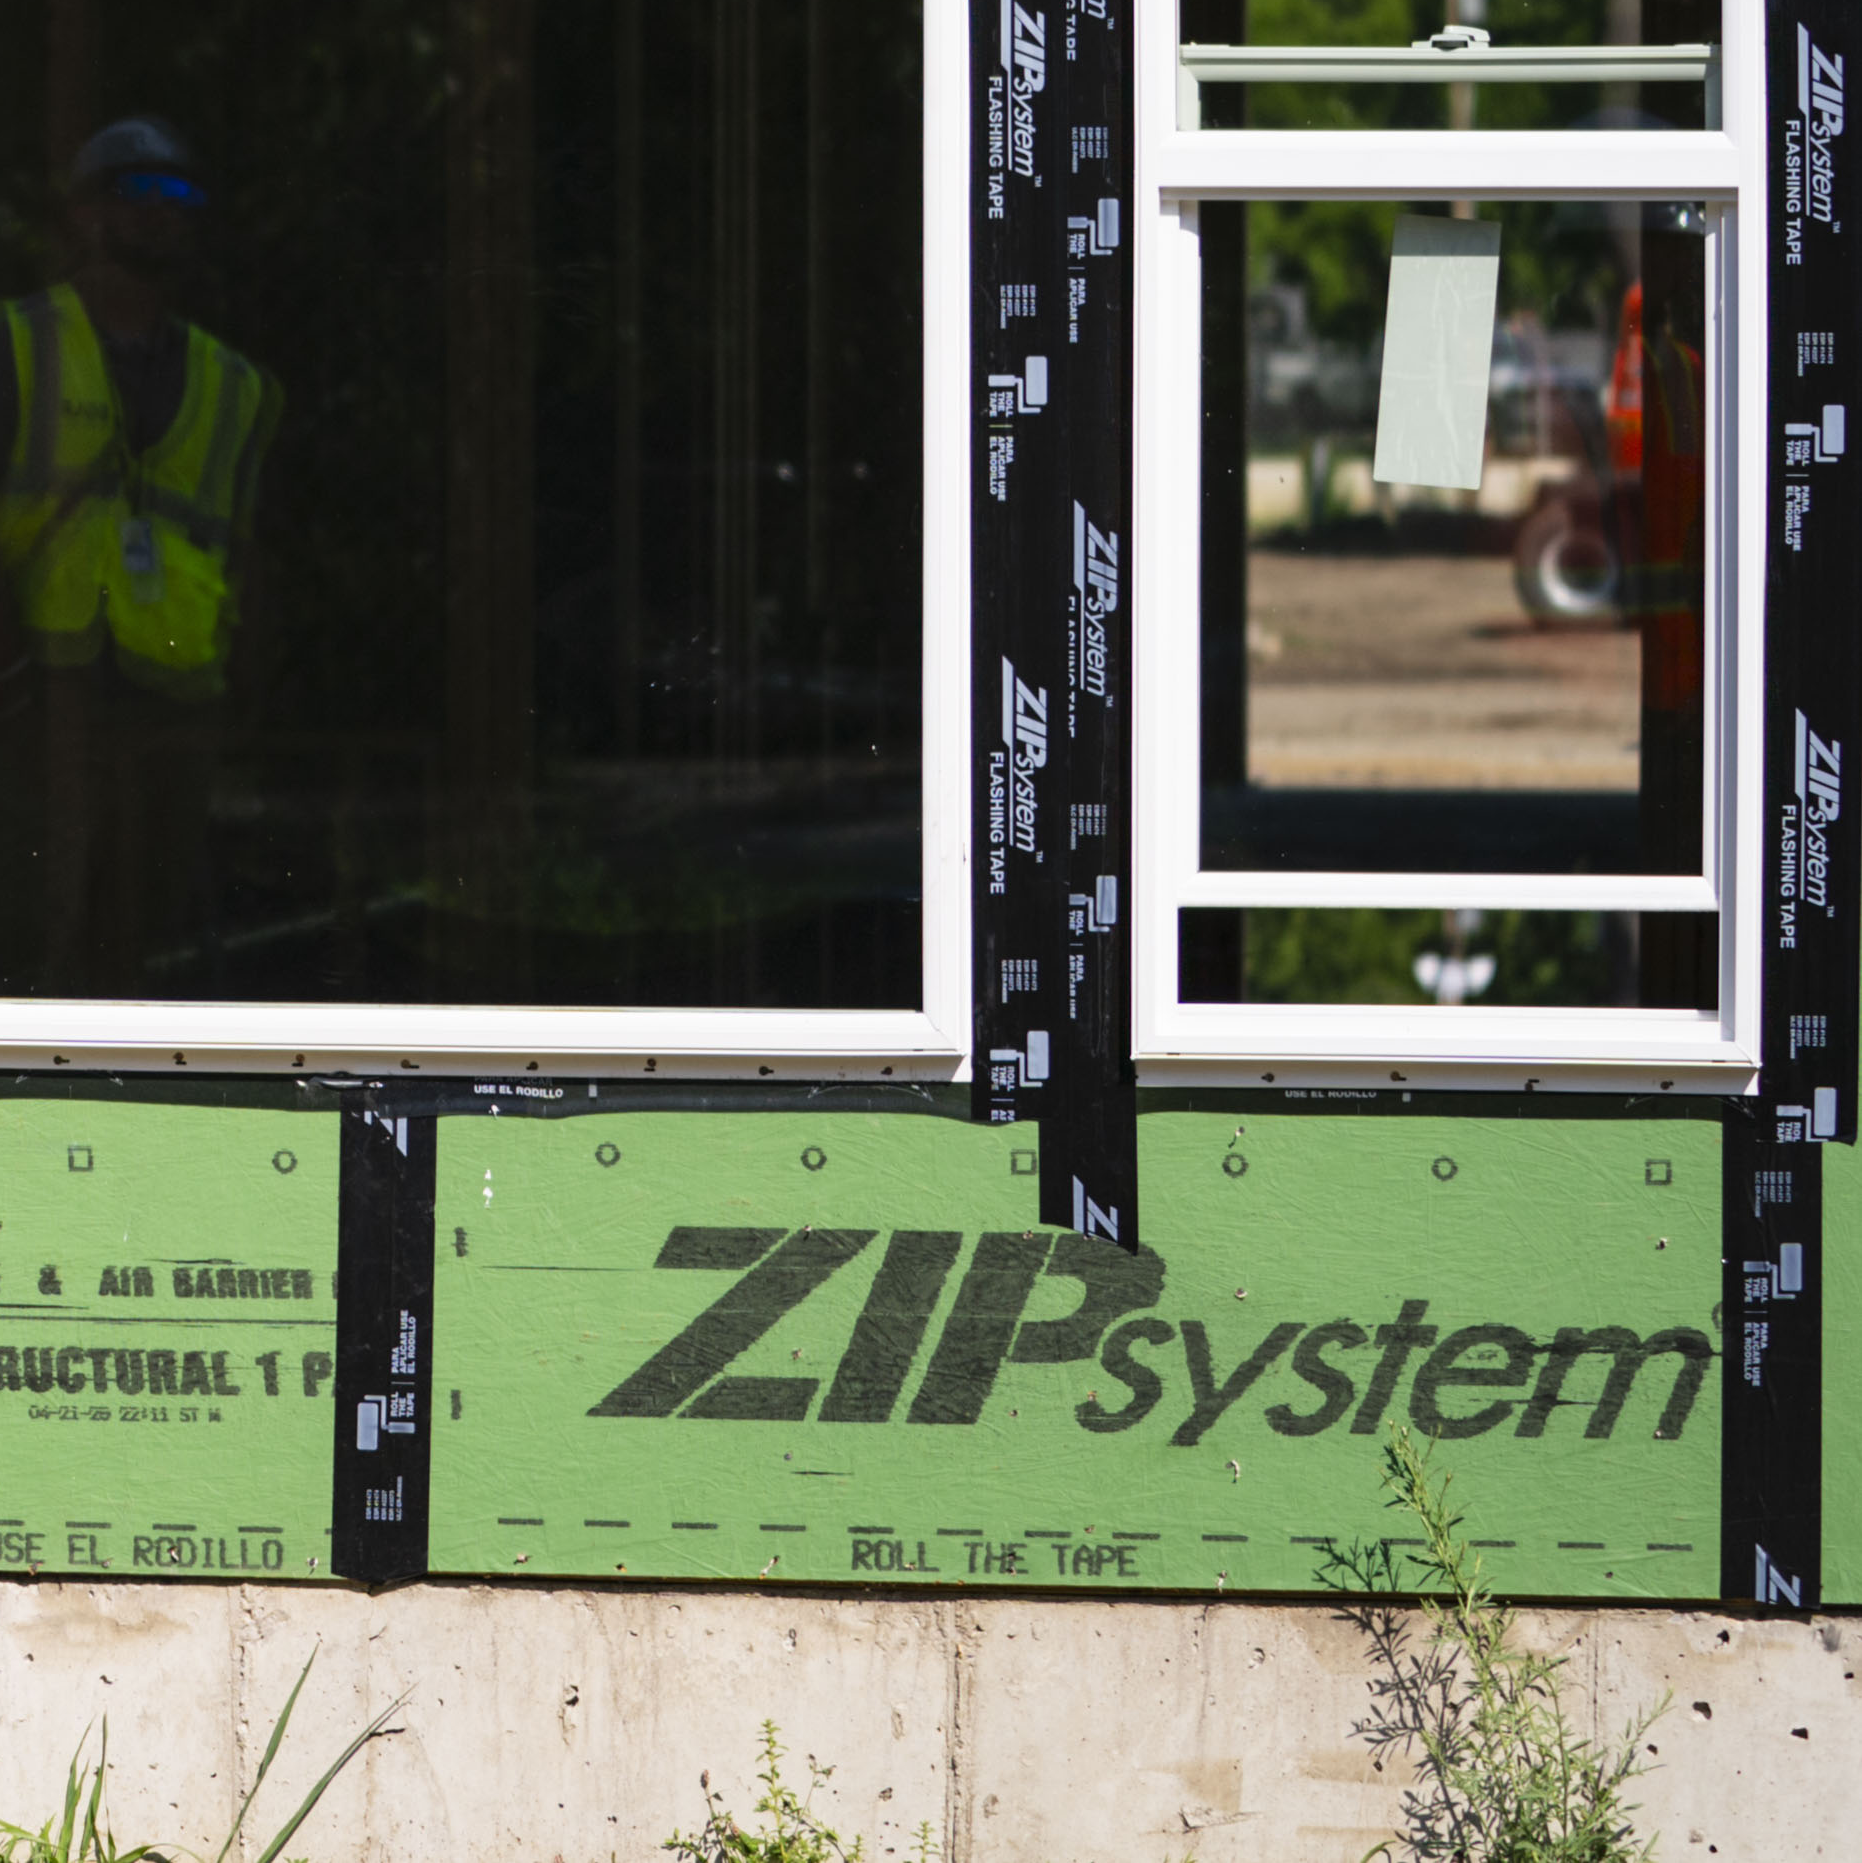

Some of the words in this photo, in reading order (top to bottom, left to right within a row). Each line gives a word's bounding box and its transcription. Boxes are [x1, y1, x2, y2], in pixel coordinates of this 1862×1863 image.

[990, 752, 1004, 842] FLASHING
[990, 848, 1004, 894] TAPE
[1781, 805, 1796, 896] FLASHING
[1780, 902, 1795, 948] TAPE
[99, 1266, 154, 1298] AIR
[173, 1266, 312, 1300] BARRIER
[301, 1352, 338, 1396] P
[67, 1531, 111, 1565] EL
[131, 1532, 285, 1571] RODILLO
[851, 1540, 941, 1574] ROLL
[965, 1543, 1033, 1576] THE
[1055, 1544, 1139, 1578] TAPE
